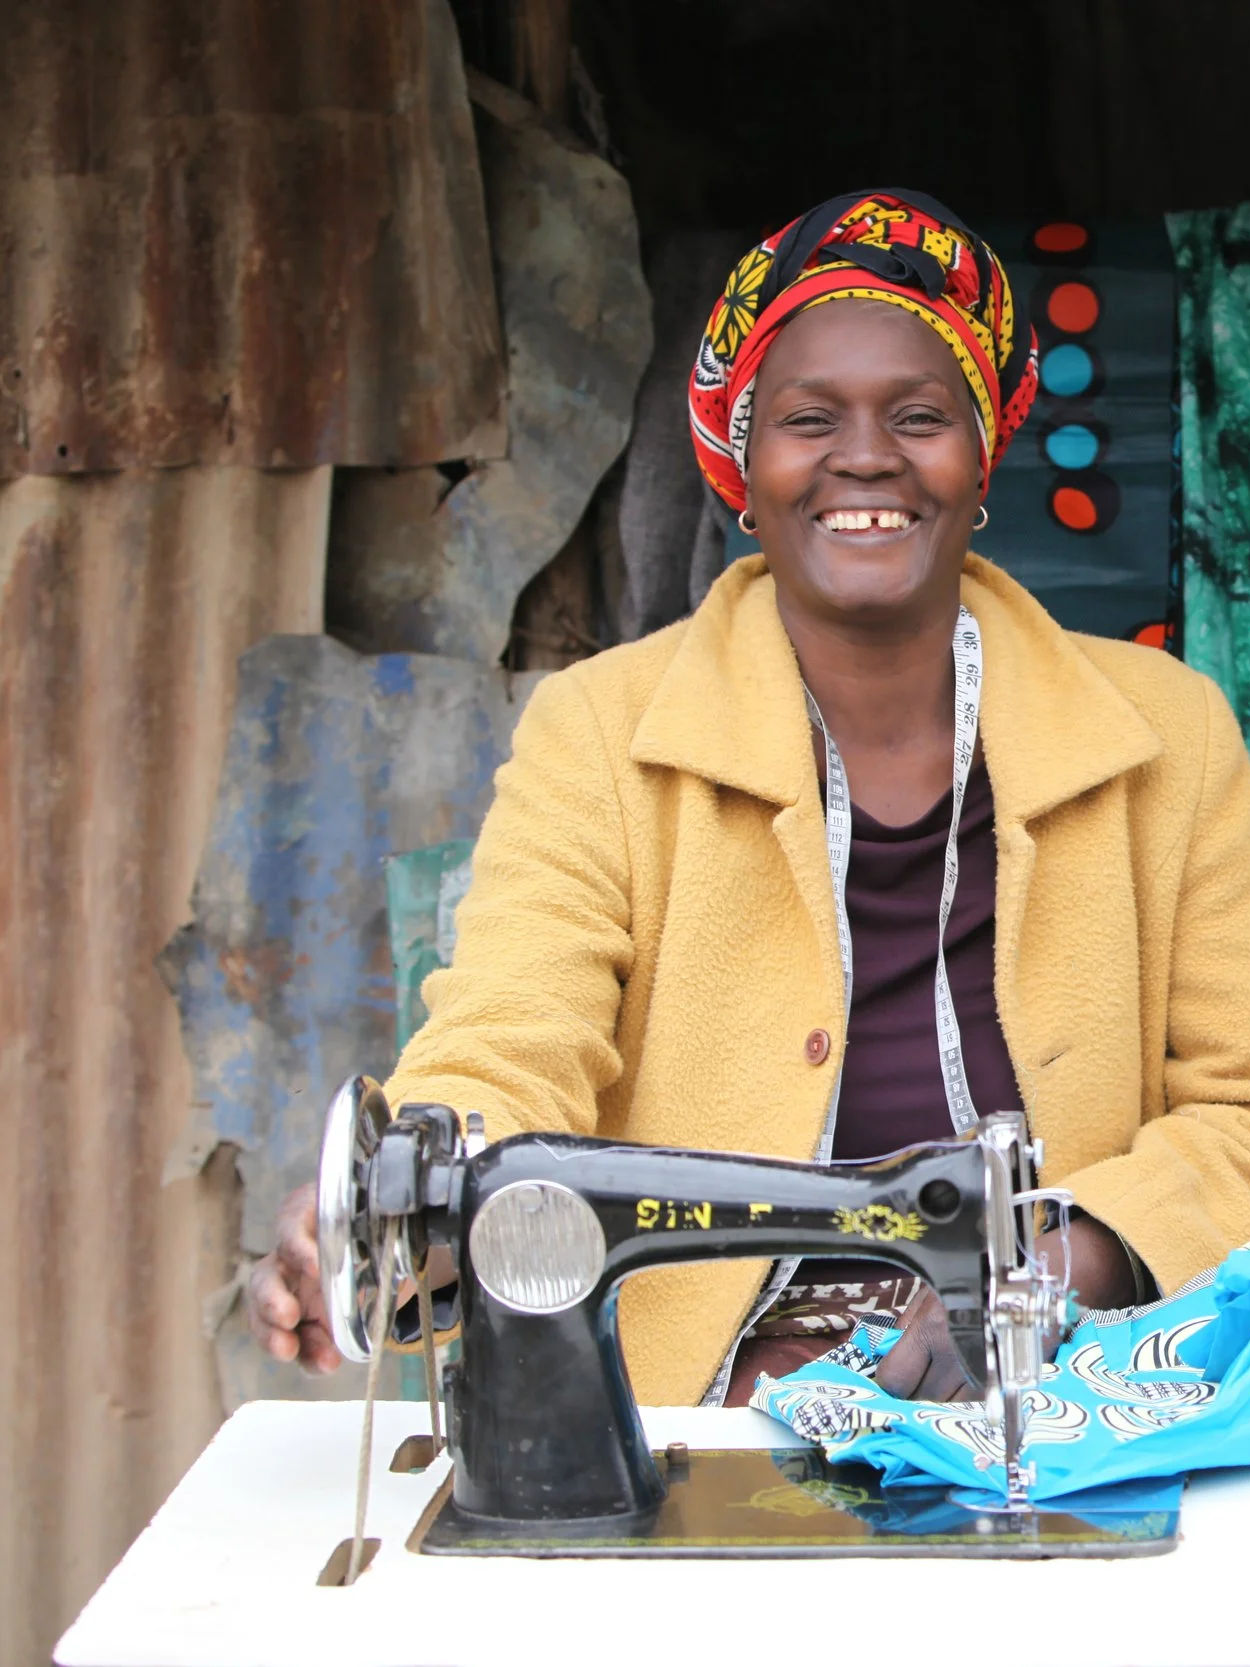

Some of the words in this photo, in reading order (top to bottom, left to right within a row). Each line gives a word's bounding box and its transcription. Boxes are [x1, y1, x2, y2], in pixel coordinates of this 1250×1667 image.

[962, 631, 978, 650] 30
[965, 663, 979, 688] 29
[963, 702, 976, 727] 28
[960, 740, 972, 766] 27
[832, 784, 843, 794] 109
[832, 800, 844, 810] 110
[833, 816, 843, 826] 111
[831, 833, 843, 843] 112
[830, 849, 841, 859] 113
[946, 1033, 953, 1043] 51
[956, 1100, 964, 1109] 47
